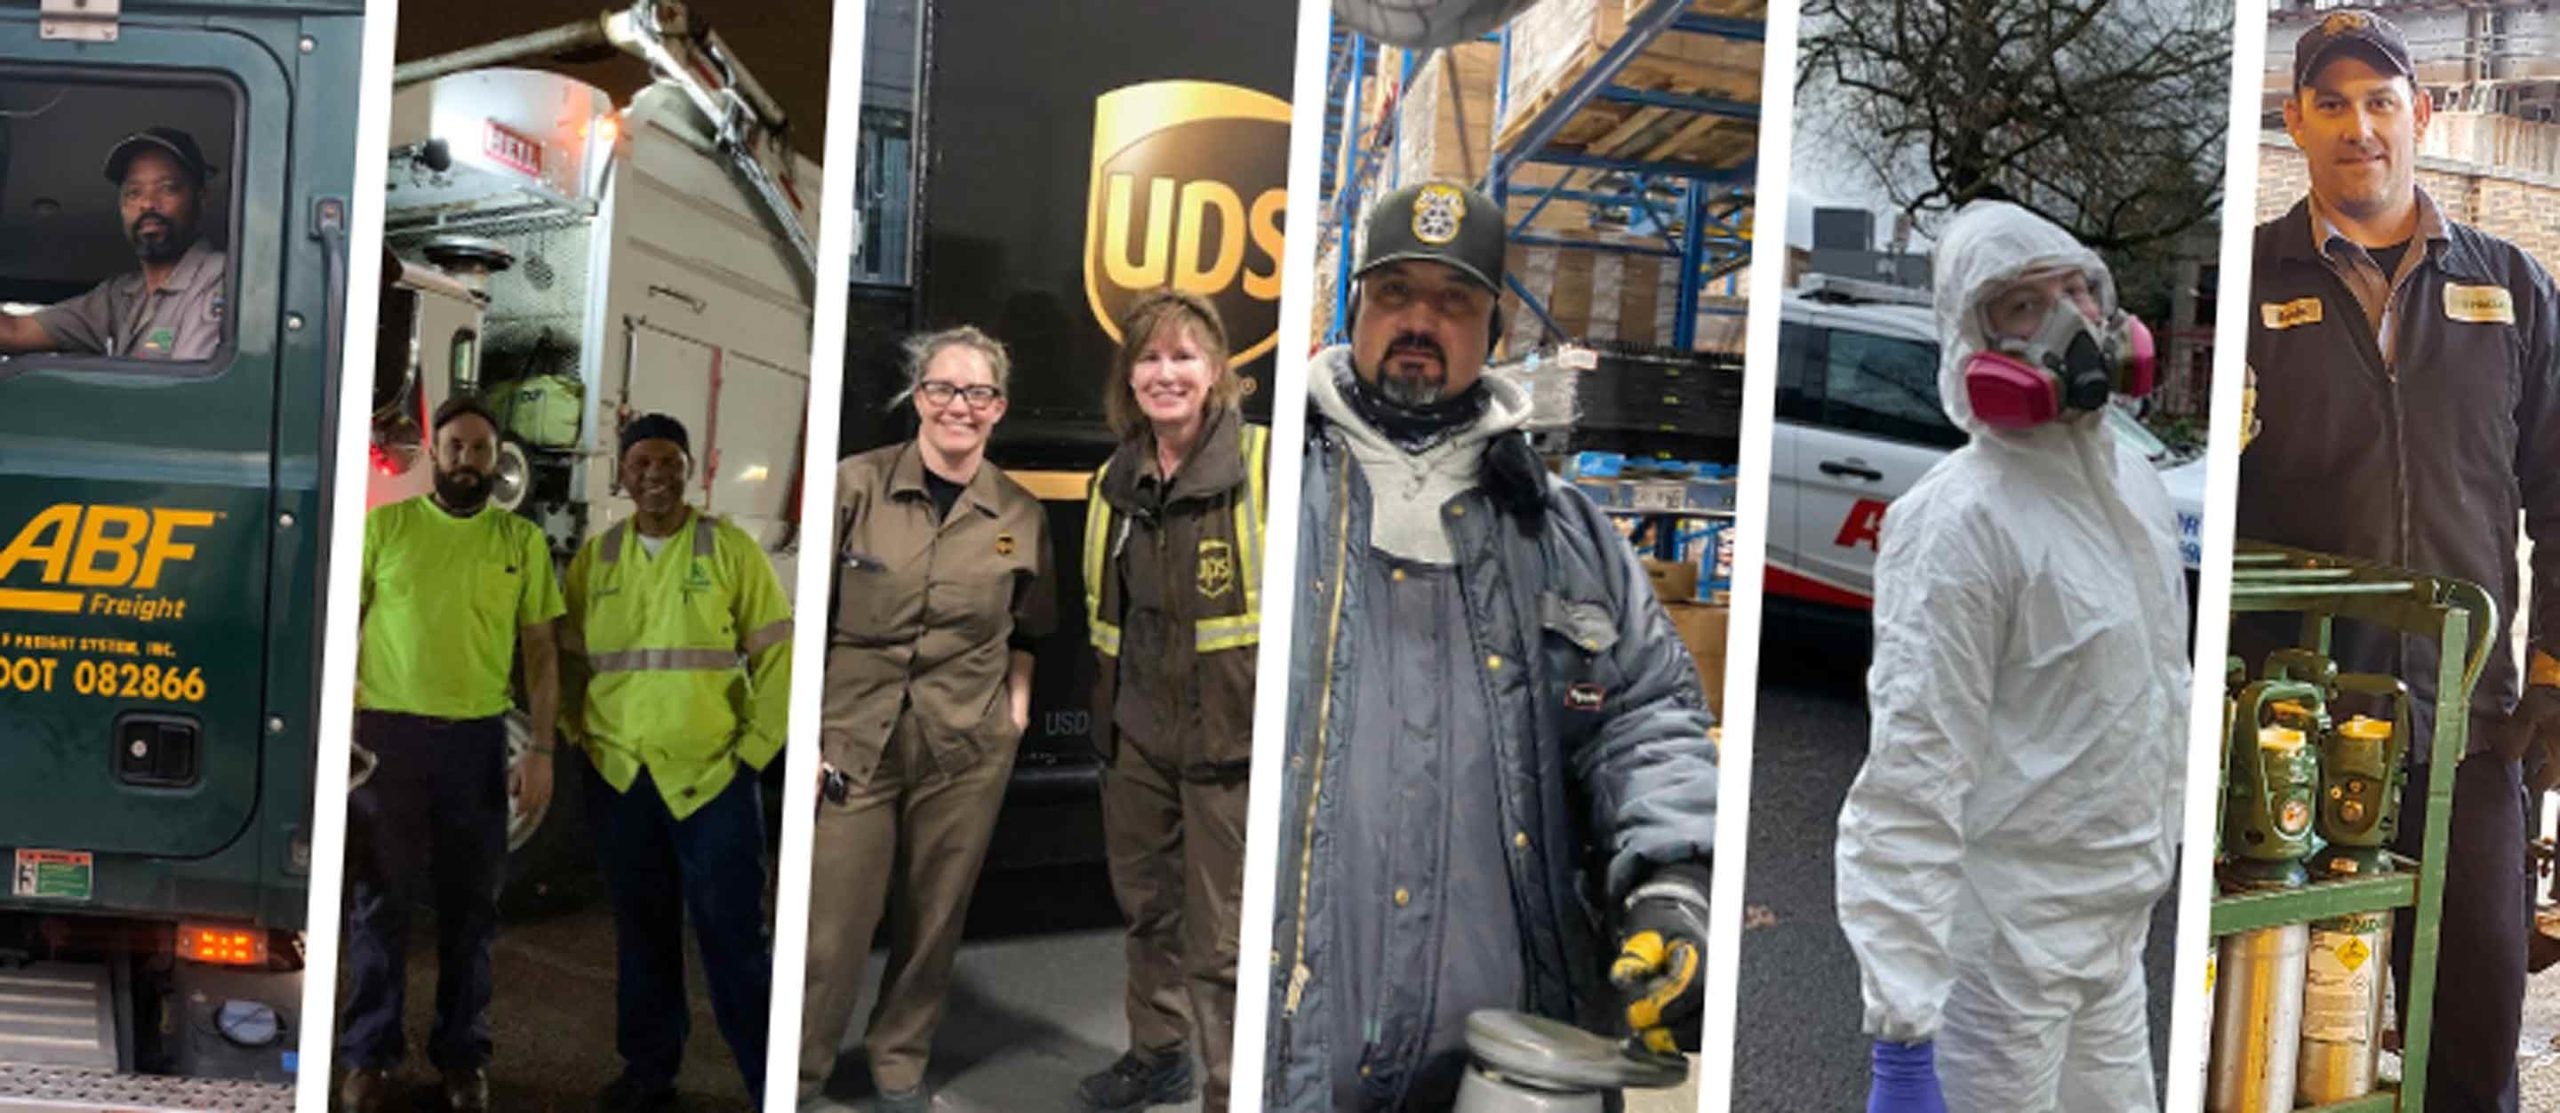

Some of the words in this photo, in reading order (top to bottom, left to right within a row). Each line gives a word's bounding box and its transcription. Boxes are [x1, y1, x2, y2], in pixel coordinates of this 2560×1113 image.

[0, 502, 214, 589] ABF
[90, 593, 187, 622] Freight
[15, 633, 76, 650] FREIGHT
[74, 660, 207, 702] 082866
